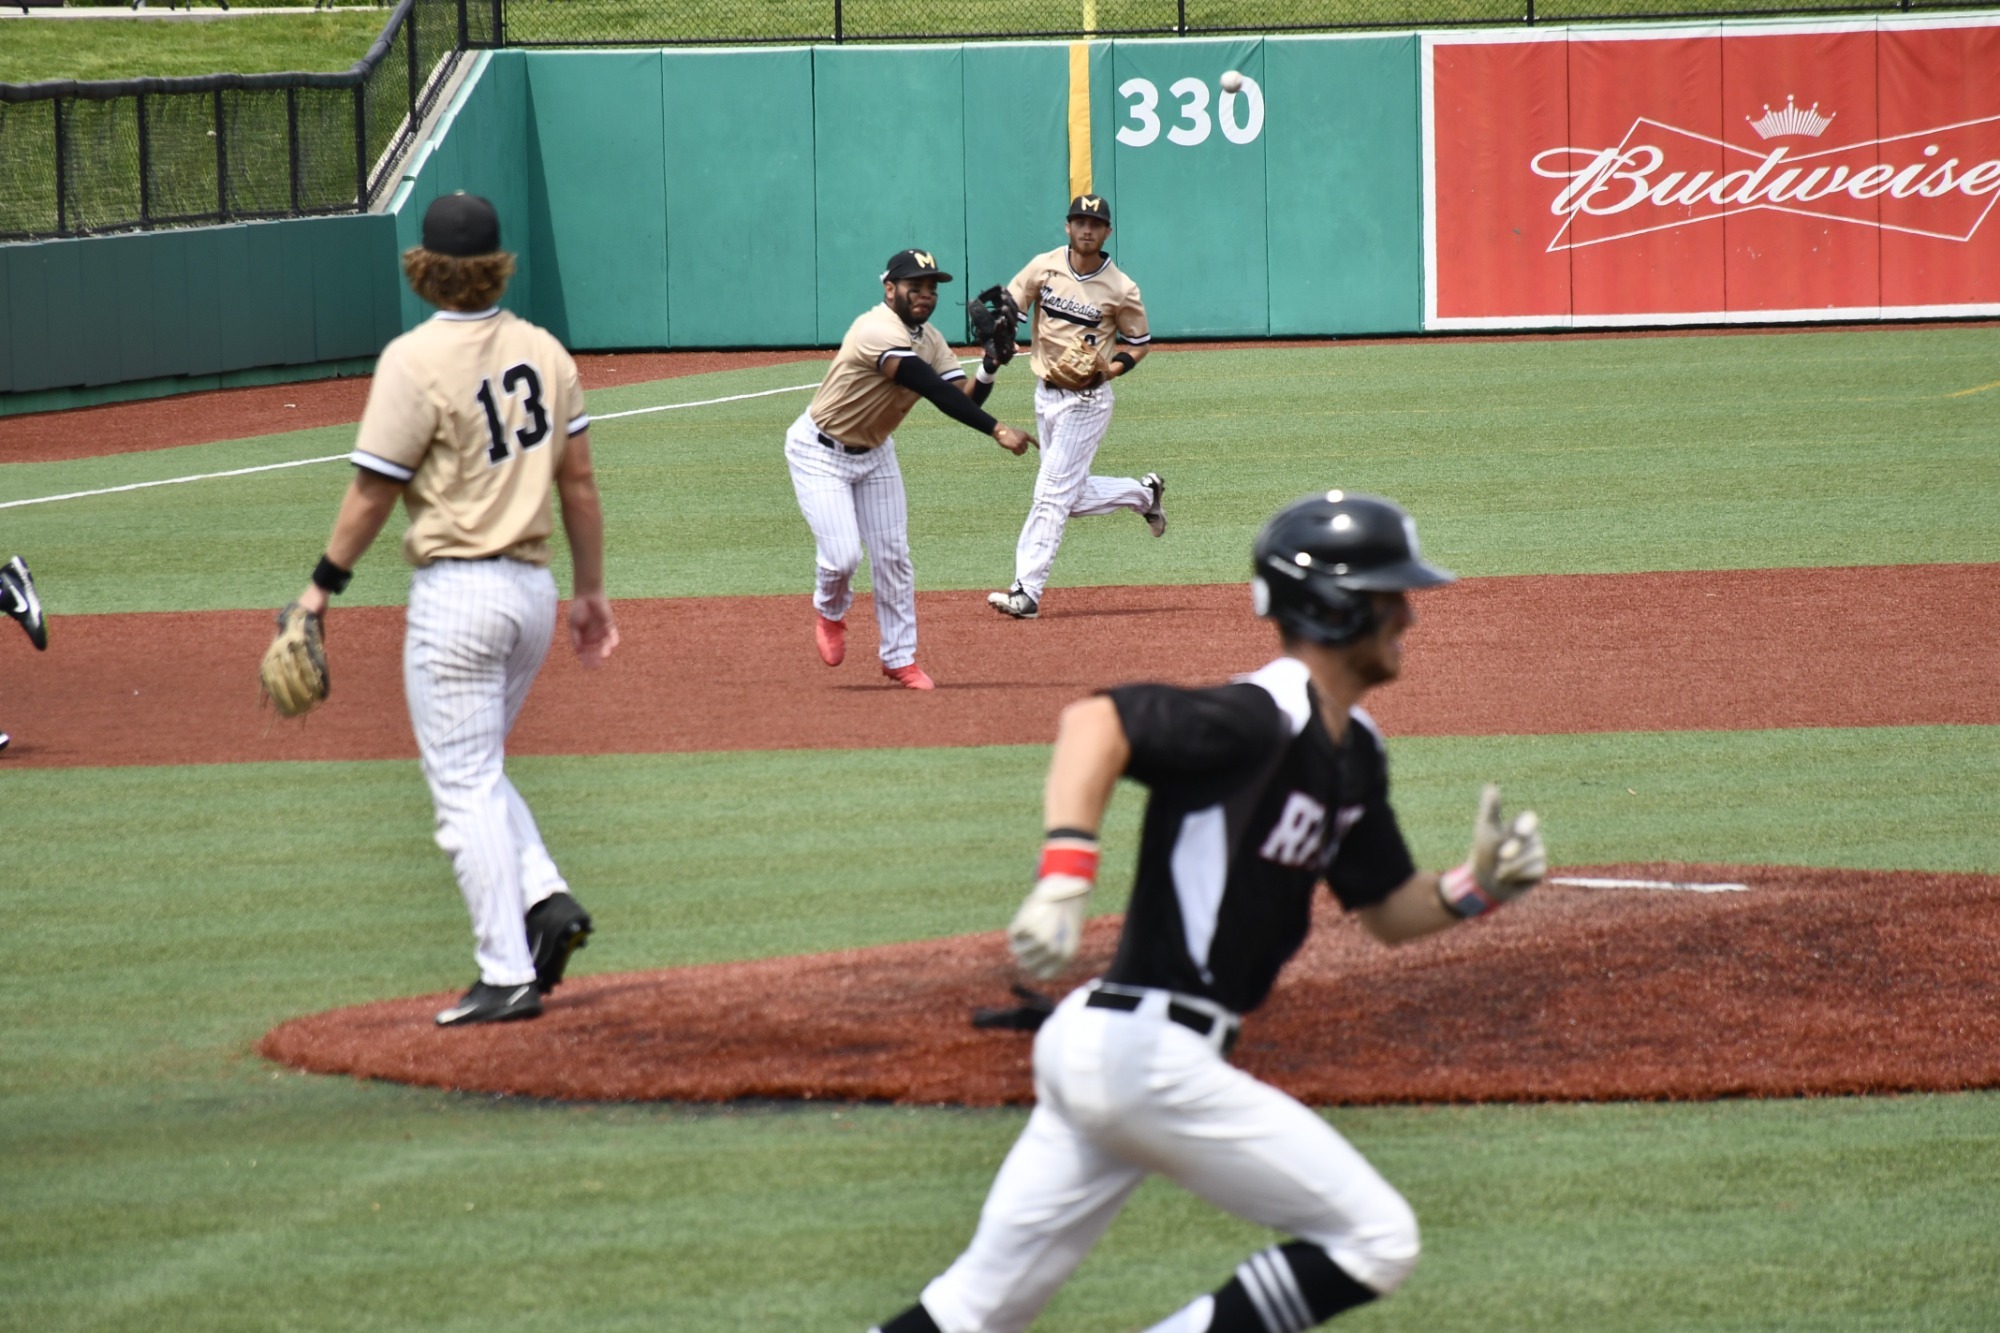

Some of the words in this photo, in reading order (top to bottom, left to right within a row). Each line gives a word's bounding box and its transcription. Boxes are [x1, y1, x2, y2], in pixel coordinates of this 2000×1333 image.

[1115, 76, 1265, 147] 330
[1081, 196, 1100, 212] M
[914, 251, 936, 269] M
[1040, 285, 1103, 320] Manchester
[476, 362, 550, 465] 13
